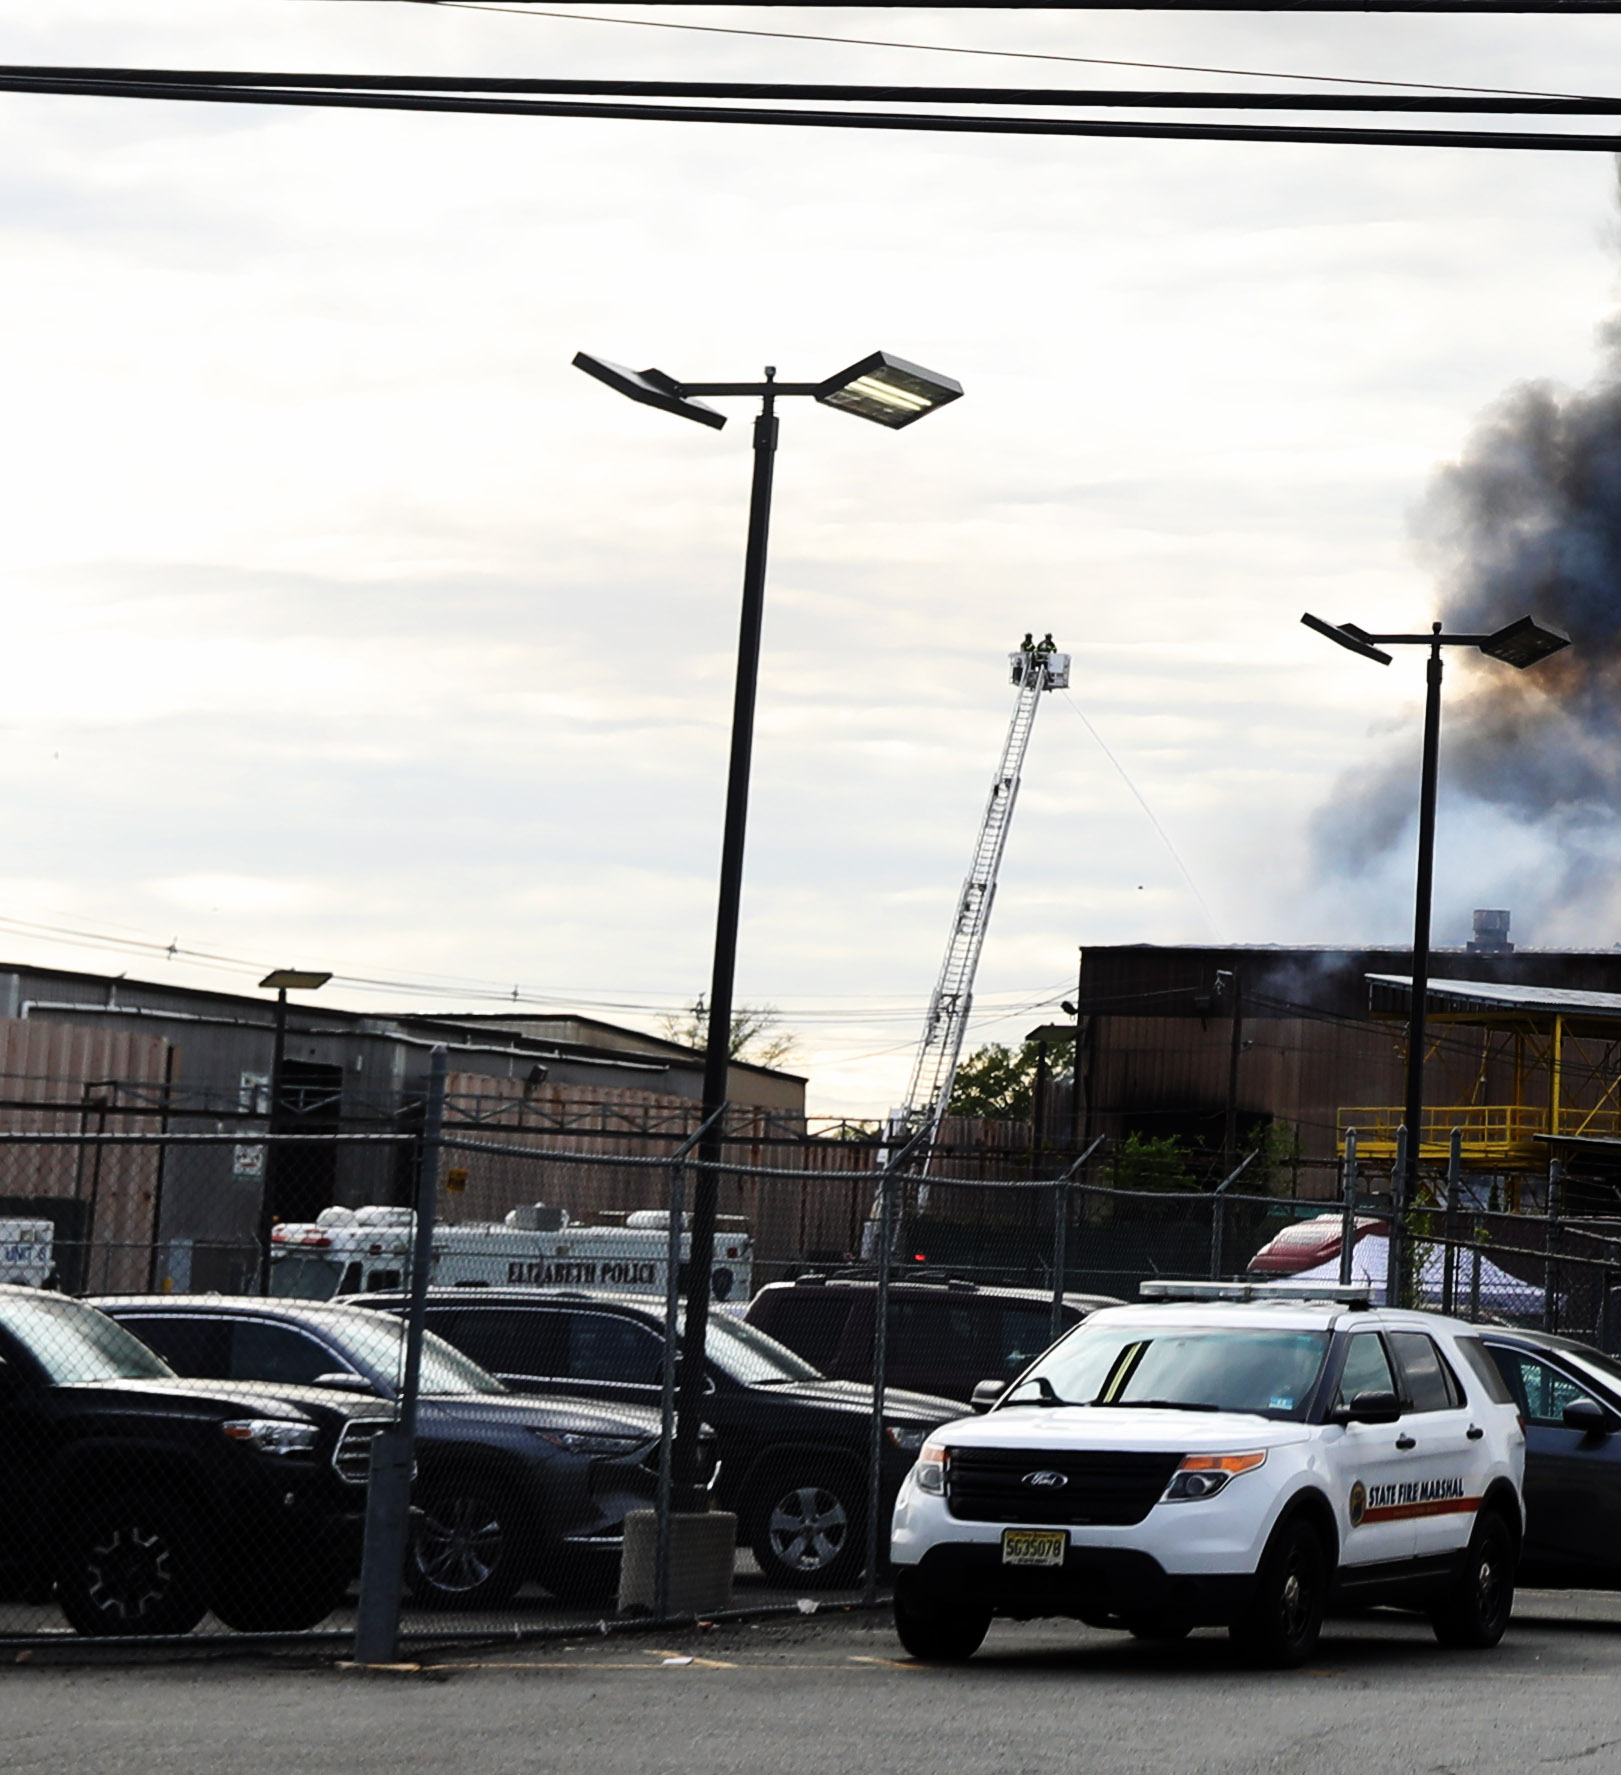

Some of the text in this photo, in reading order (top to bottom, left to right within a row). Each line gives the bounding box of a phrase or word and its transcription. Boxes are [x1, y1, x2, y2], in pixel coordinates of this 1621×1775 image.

[508, 1262, 657, 1285] ELIZABETH POLICE
[1368, 1477, 1465, 1508] STATE FIRE MARSHAL
